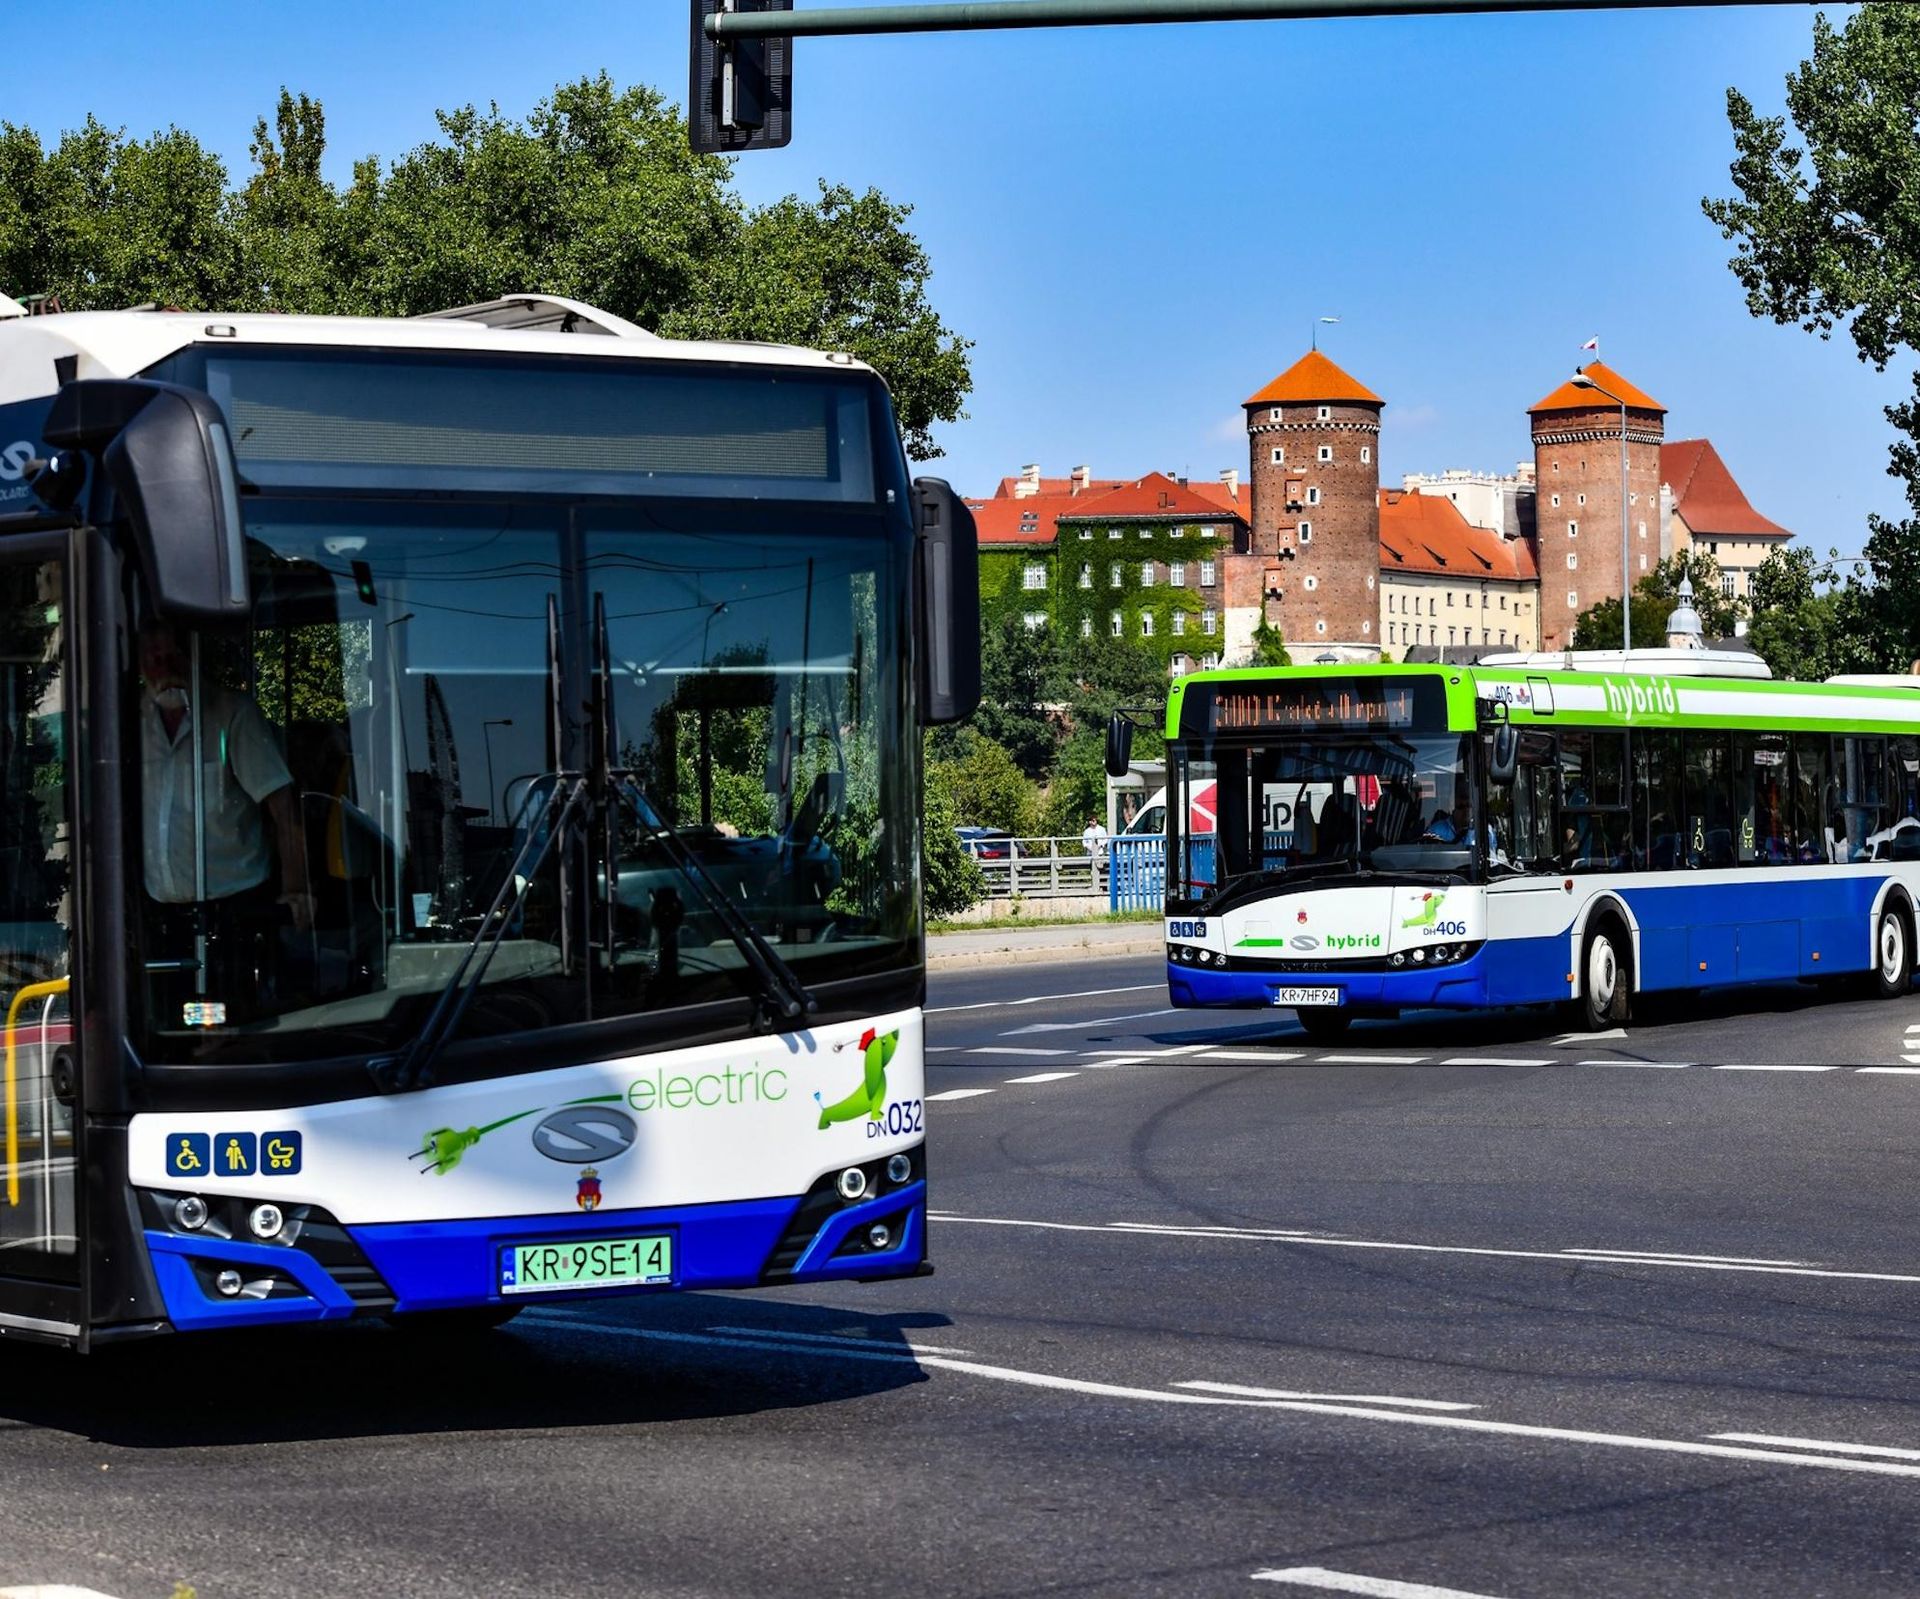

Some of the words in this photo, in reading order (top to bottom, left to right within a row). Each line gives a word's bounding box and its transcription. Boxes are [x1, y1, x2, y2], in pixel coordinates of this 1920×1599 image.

[1604, 676, 1676, 721] hybrid
[1327, 934, 1380, 950] hybrid
[1281, 989, 1297, 1002] KR
[1300, 989, 1336, 1002] 7HF94
[628, 1061, 788, 1112] electric
[867, 1099, 922, 1138] DN032
[522, 1248, 559, 1282] KR
[572, 1241, 662, 1279] 9SE14
